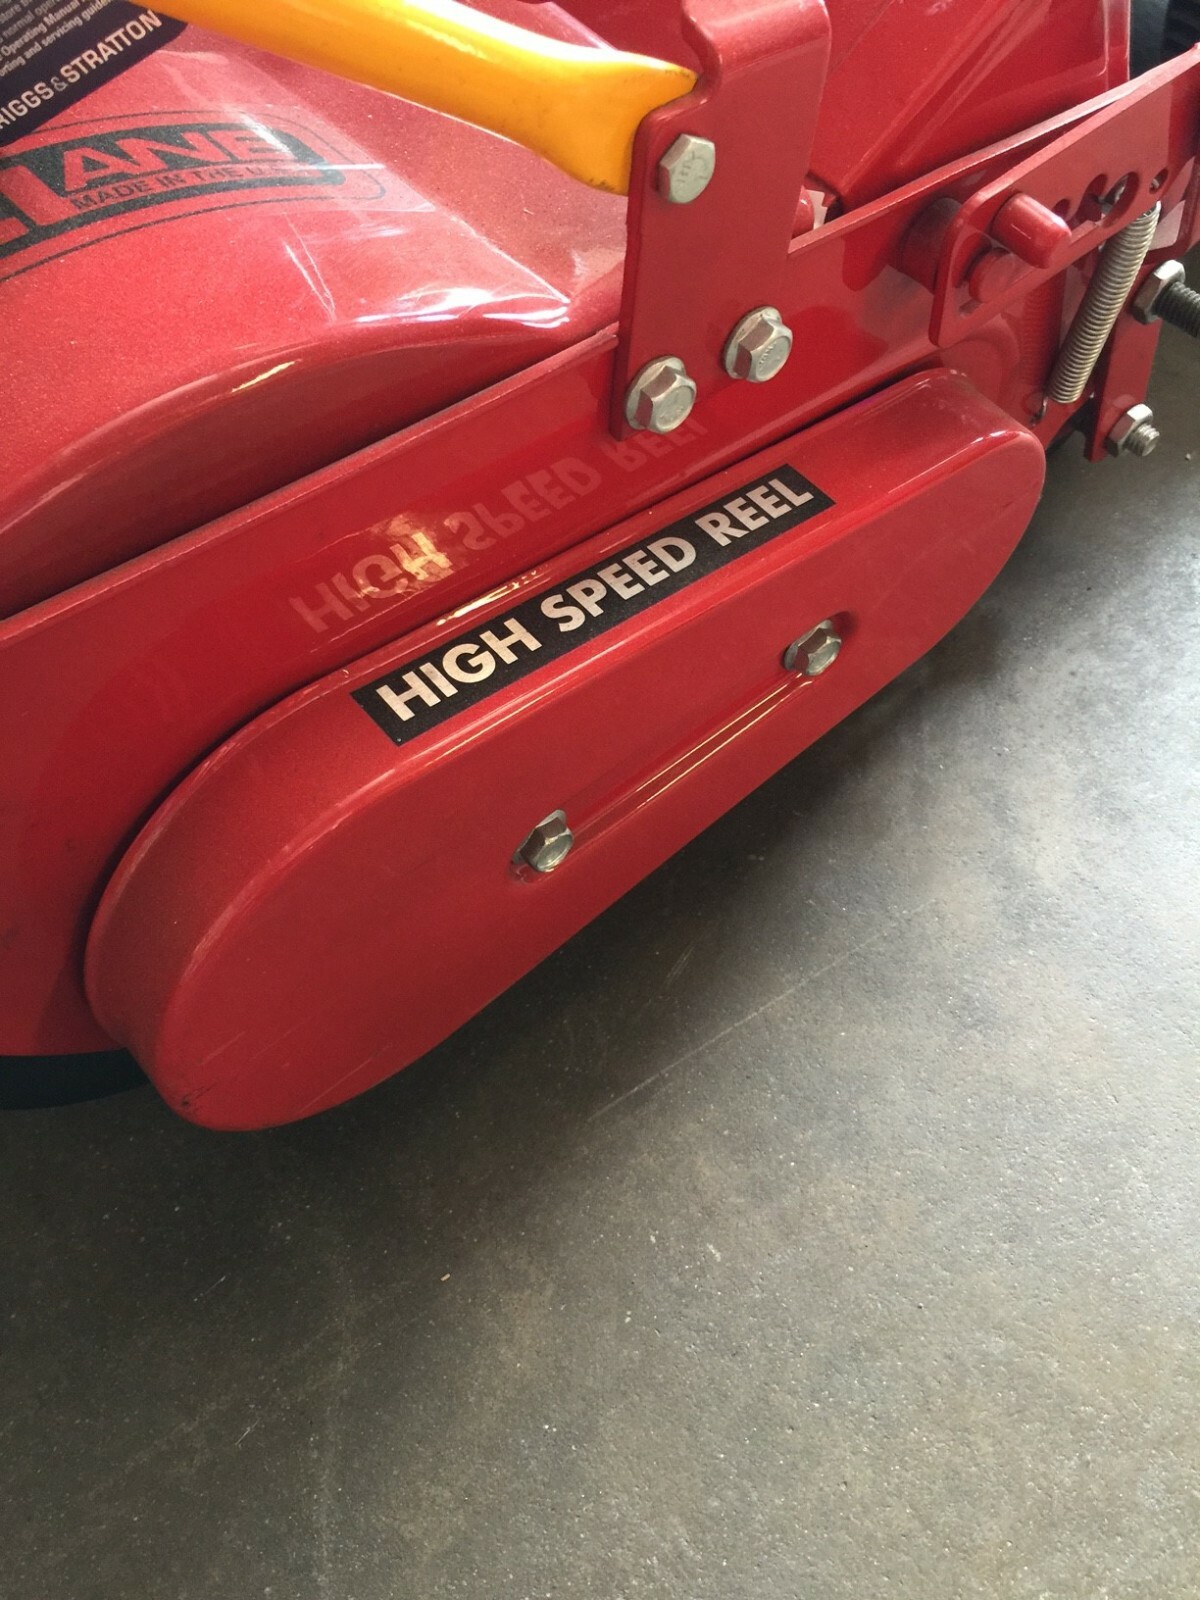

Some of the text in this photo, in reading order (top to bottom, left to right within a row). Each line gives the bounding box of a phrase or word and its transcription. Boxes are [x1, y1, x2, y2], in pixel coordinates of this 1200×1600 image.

[1, 0, 80, 56] Operating Manual
[24, 42, 42, 59] and
[42, 16, 83, 47] servicing
[70, 180, 153, 210] MADE
[155, 172, 182, 189] IN
[193, 166, 240, 183] THE
[376, 478, 814, 722] HIGH SPEED REEL
